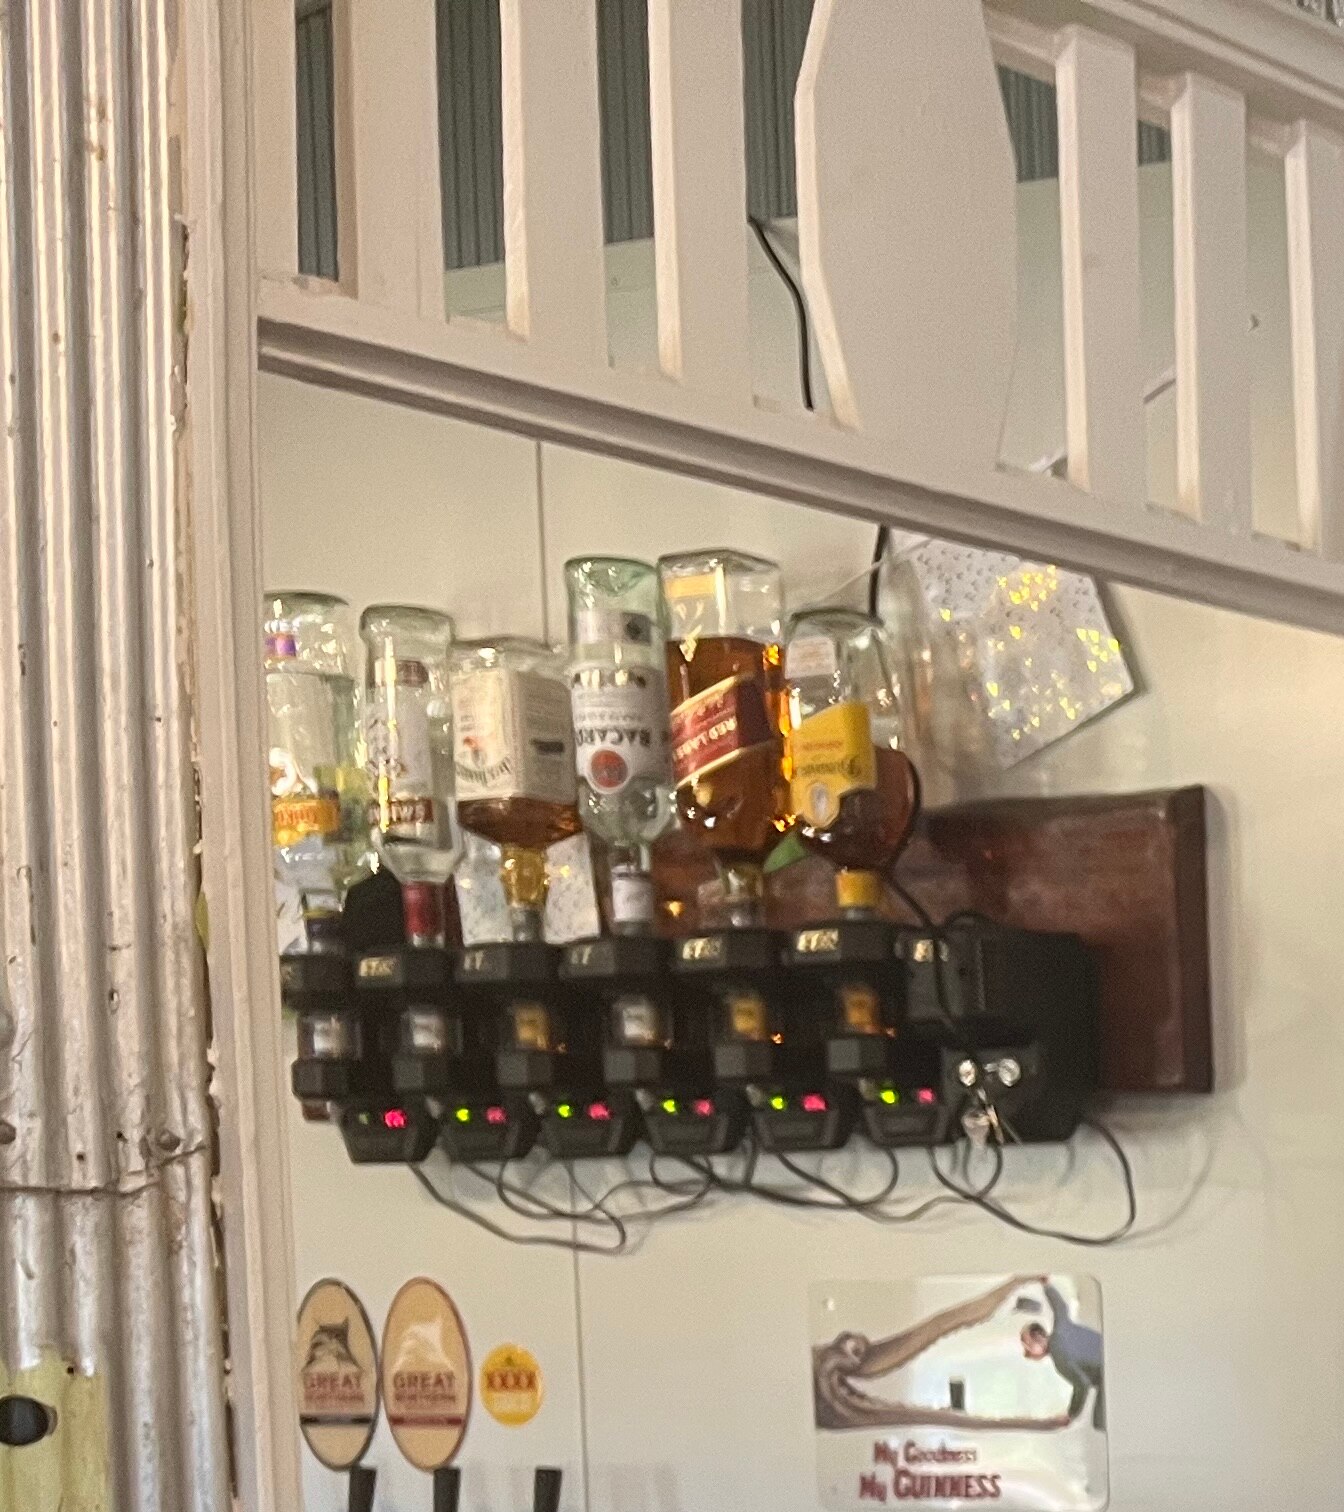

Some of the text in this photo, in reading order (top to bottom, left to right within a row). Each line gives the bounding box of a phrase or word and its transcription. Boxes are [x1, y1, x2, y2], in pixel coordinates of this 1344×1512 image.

[873, 1440, 899, 1468] My
[858, 1467, 1002, 1504] My GUINNESS
